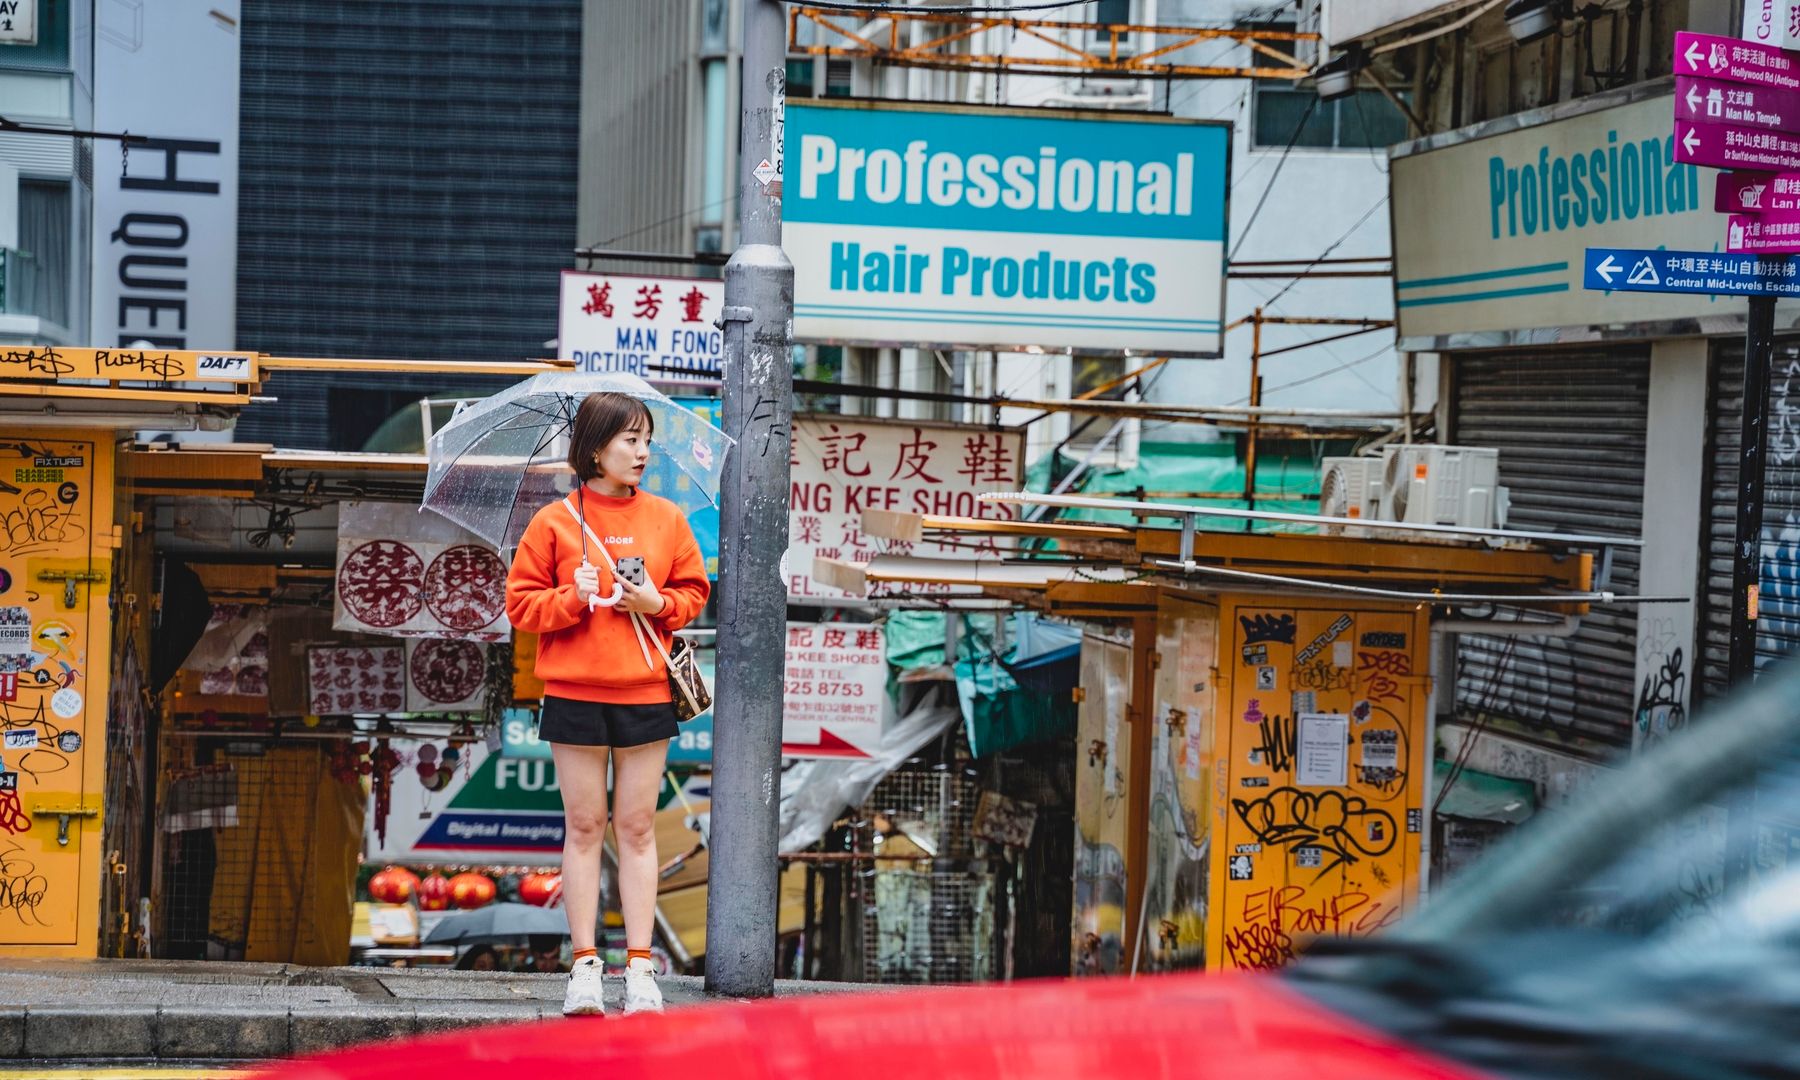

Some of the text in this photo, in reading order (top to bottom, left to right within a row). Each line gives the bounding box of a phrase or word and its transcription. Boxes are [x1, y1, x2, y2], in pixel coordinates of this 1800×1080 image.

[1731, 66, 1764, 81] Hollywood
[1765, 72, 1774, 83] Rd
[1727, 89, 1754, 106] 文武廟
[1726, 107, 1781, 126] Man Mo Temple
[120, 138, 220, 195] H
[800, 133, 1194, 215] Professional
[1772, 197, 1794, 209] Lan
[829, 241, 1156, 304] Hair Products
[1666, 257, 1797, 277] 中環至半山自動扶梯
[1665, 277, 1800, 293] Central Mid-Levels Escala
[582, 282, 710, 322] 萬芳畫
[616, 327, 720, 355] MAN FONG
[200, 357, 248, 370] DAFT
[572, 350, 650, 378] PICTURE
[35, 457, 83, 466] FIXTURE
[912, 488, 1013, 521] SHOES
[604, 536, 634, 545] ADORE
[1297, 614, 1352, 665] FIXTURE
[798, 652, 827, 663] KEE
[831, 652, 880, 665] SHOES
[820, 669, 845, 680] TEL
[818, 682, 864, 697] 8753
[447, 821, 563, 840] Digital Imaging
